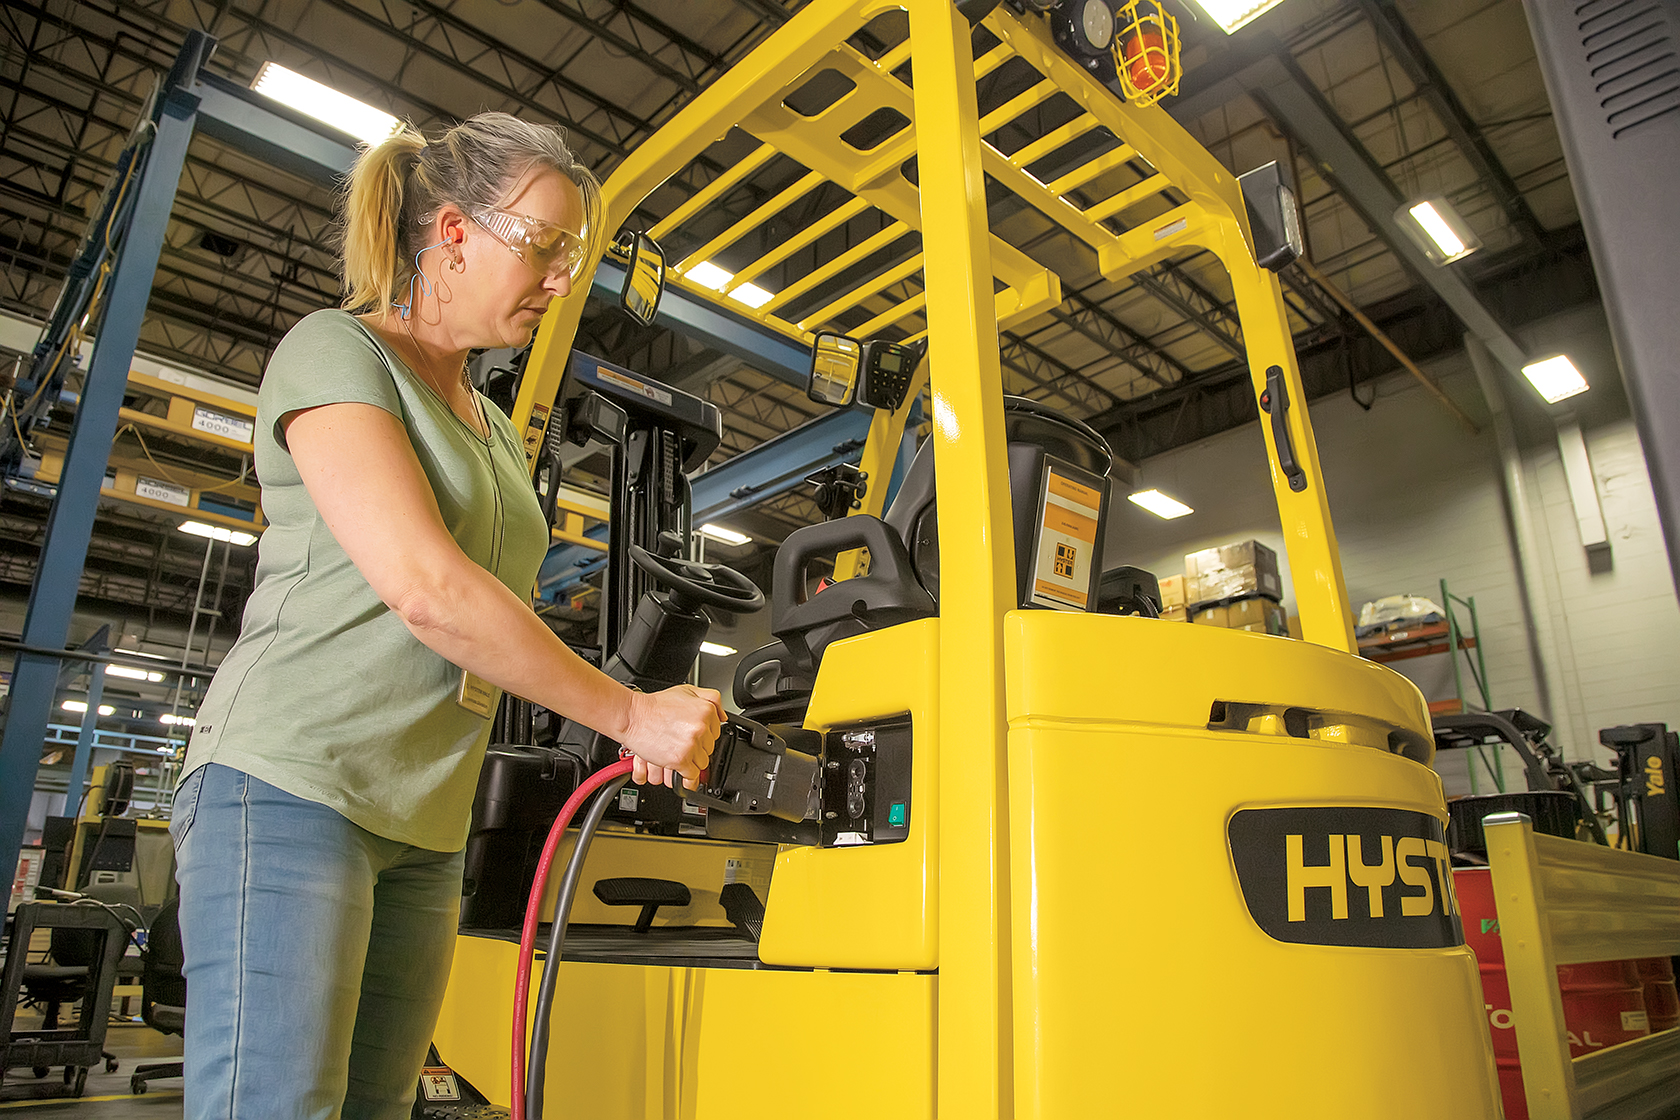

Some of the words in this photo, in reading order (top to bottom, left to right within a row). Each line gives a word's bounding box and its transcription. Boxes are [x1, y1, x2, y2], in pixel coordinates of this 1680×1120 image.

[199, 420, 229, 434] 4000
[142, 487, 169, 499] 4000
[1056, 557, 1073, 566] HYSTER
[1286, 834, 1461, 922] HYST
